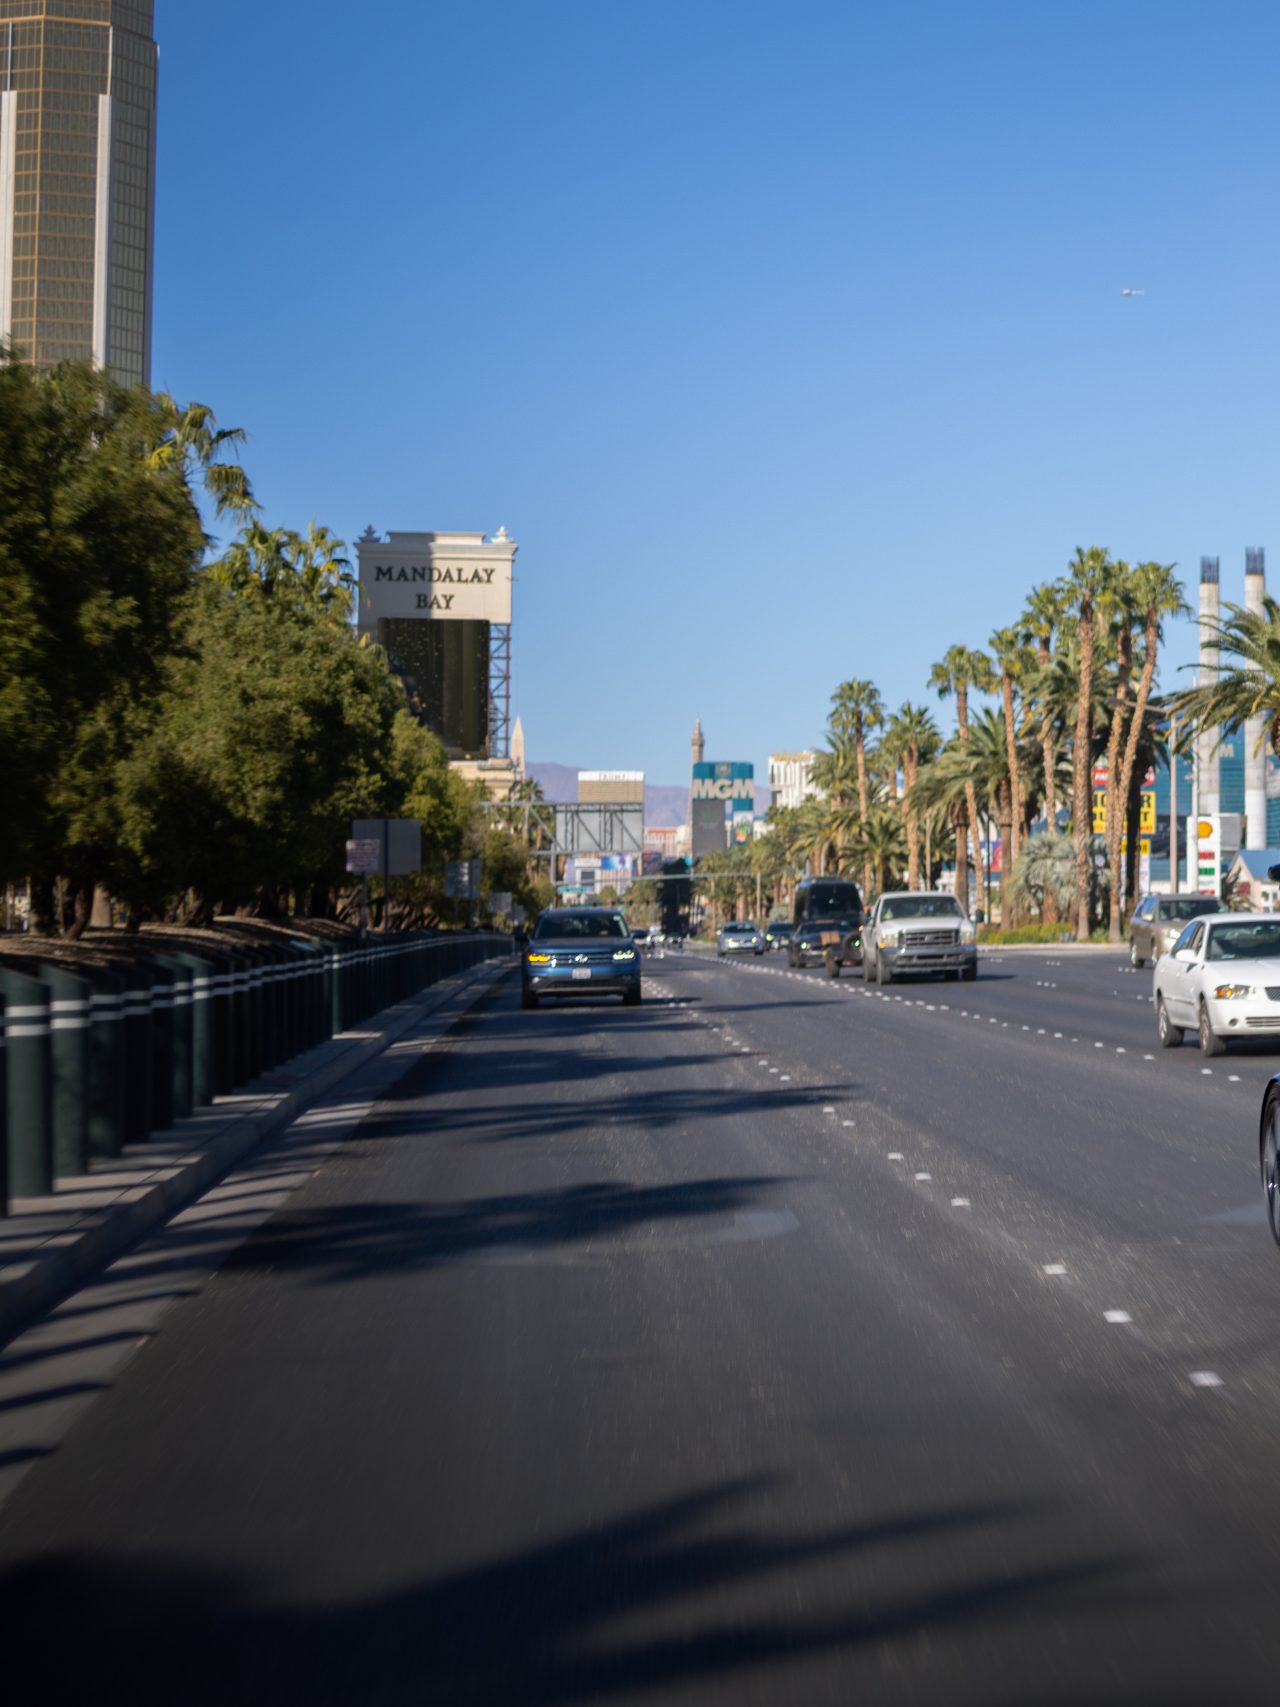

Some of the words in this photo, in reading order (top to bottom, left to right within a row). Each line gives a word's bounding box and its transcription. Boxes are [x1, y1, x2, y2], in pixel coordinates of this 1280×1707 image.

[375, 566, 496, 584] MANDALAY
[416, 593, 455, 610] BAY
[692, 778, 755, 800] MGM
